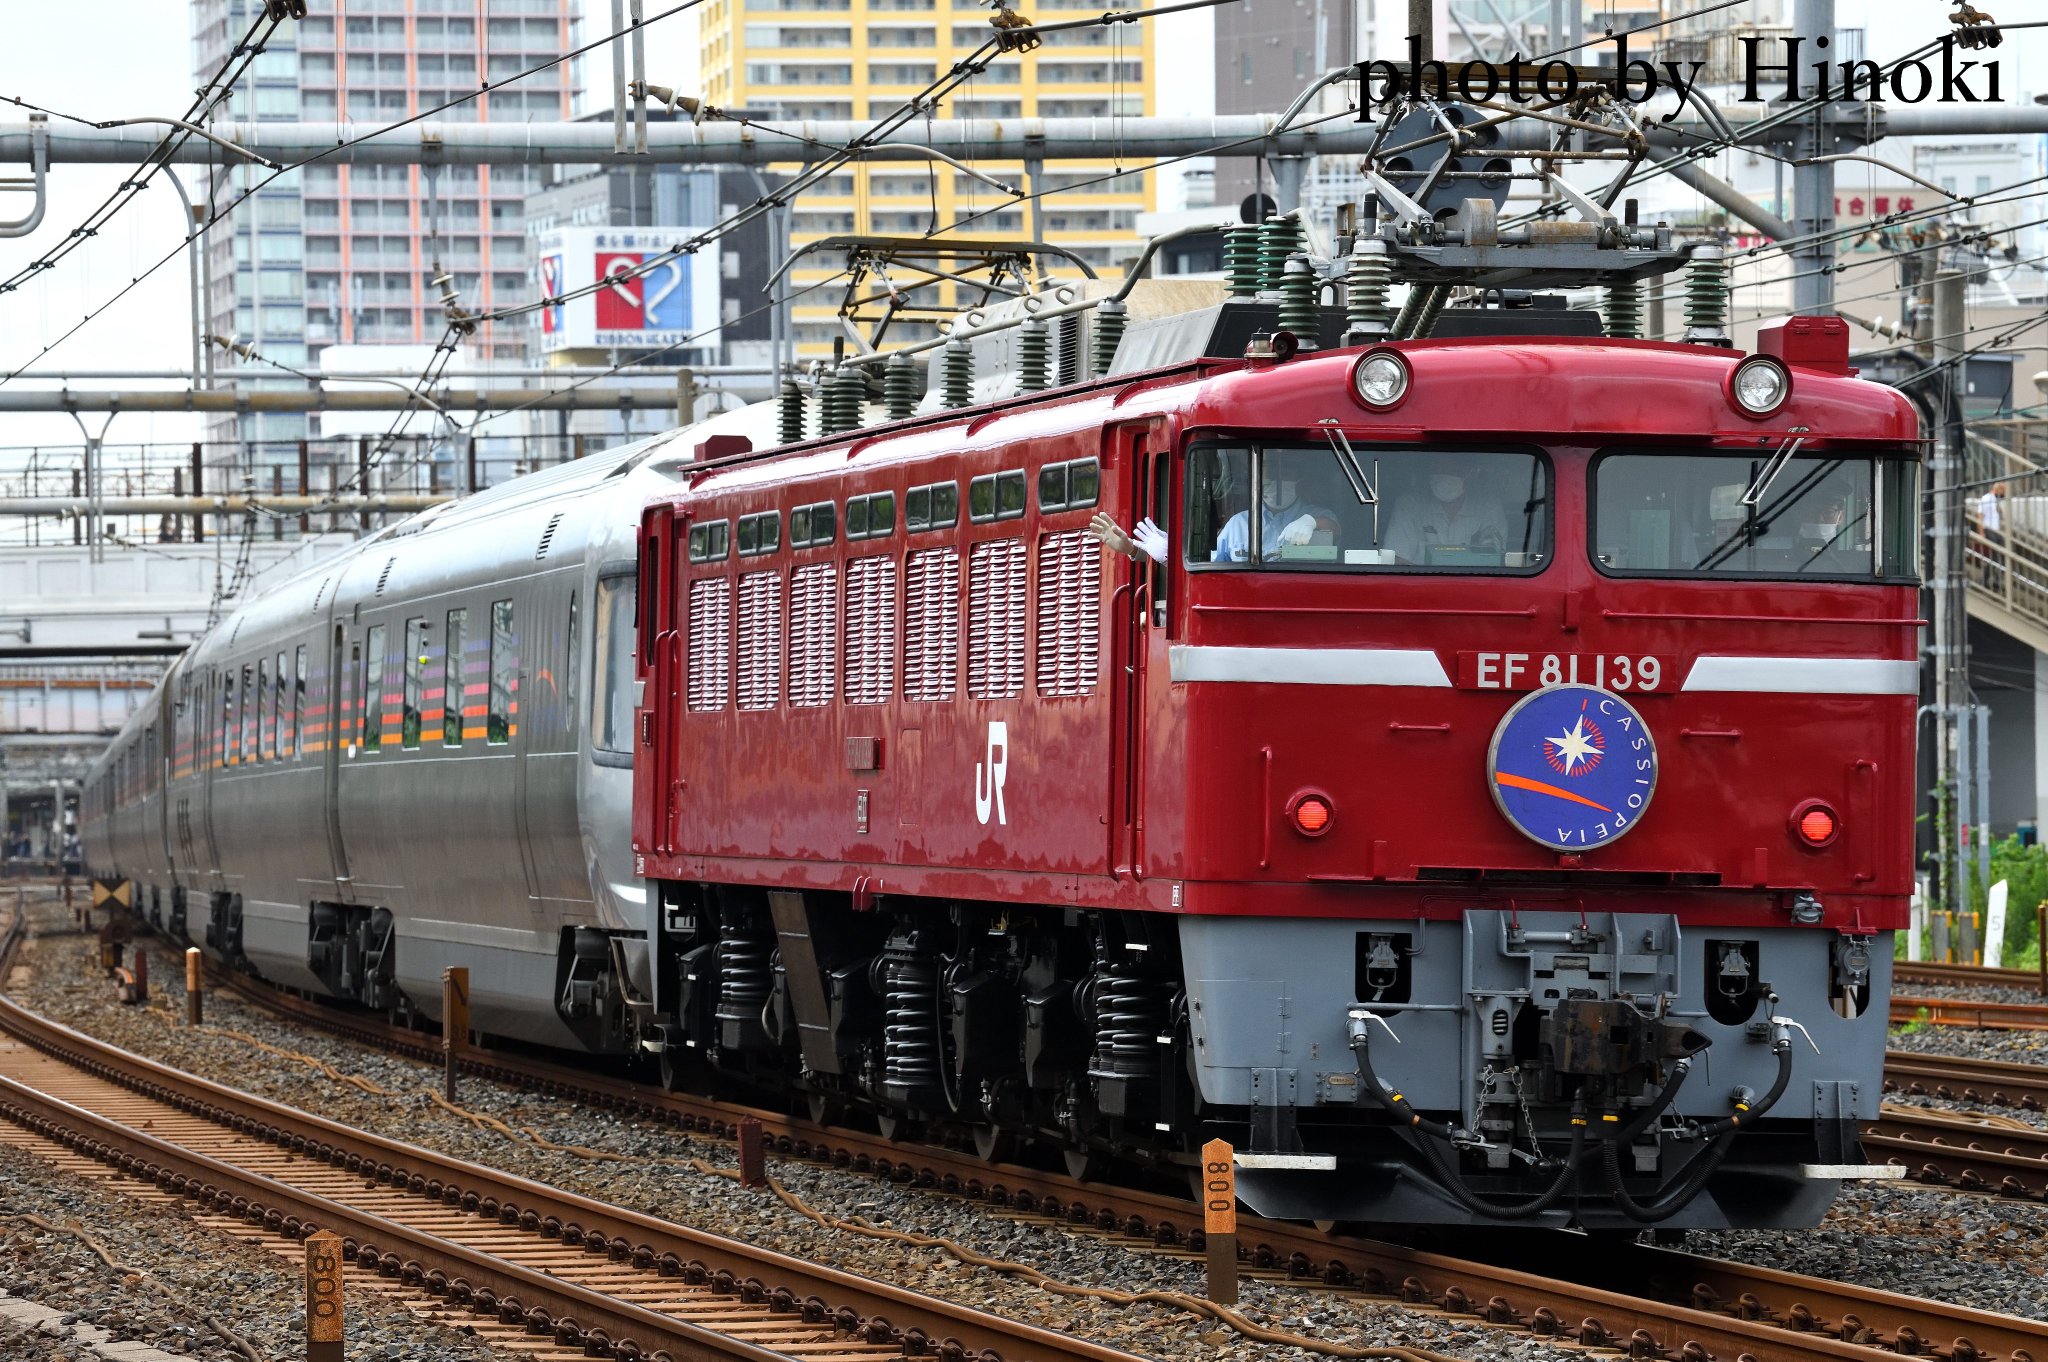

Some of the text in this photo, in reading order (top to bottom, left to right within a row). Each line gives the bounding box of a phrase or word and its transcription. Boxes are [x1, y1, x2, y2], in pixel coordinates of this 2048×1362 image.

[1477, 652, 1661, 691] EF 81 139
[975, 721, 1008, 825] JR
[1557, 699, 1651, 843] CASSIOPEIA
[1207, 1161, 1231, 1212] 800
[313, 1254, 336, 1318] 800
